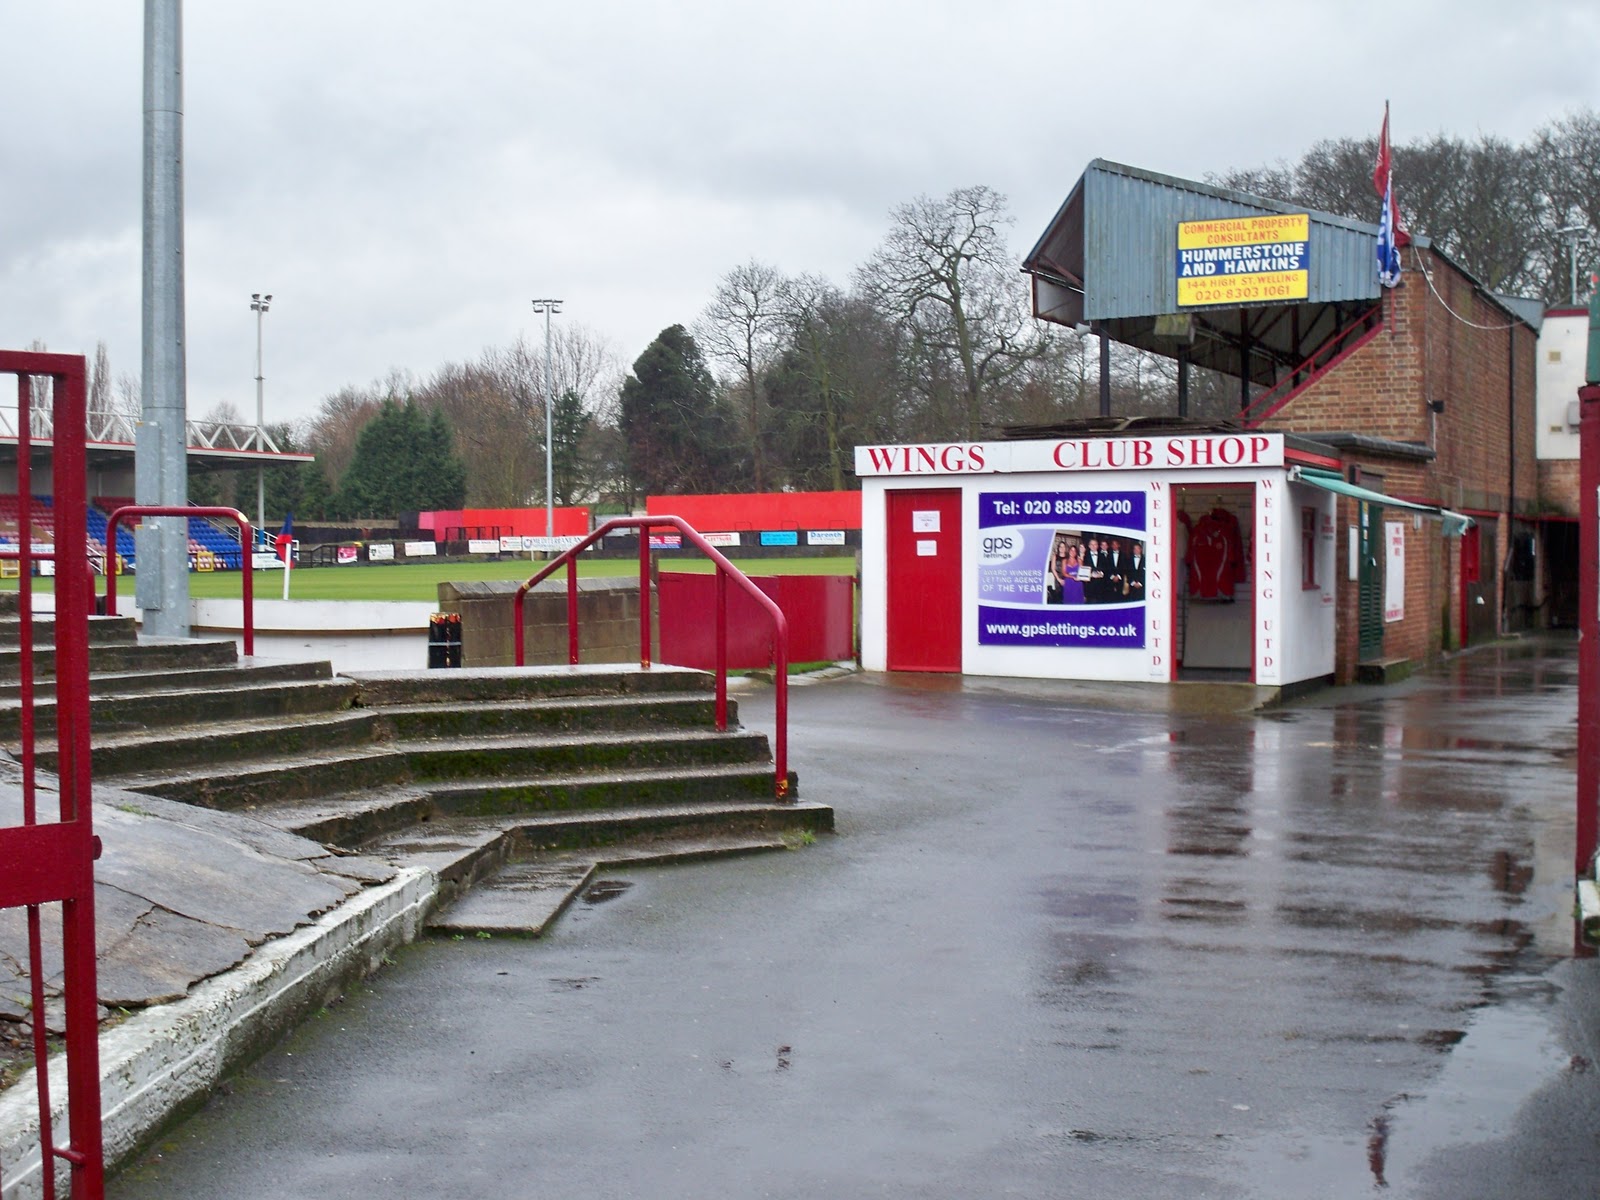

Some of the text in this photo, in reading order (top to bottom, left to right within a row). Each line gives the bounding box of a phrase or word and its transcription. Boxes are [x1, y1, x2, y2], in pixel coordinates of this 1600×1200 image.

[1184, 217, 1304, 234] COMMERCIAL PROPERTY
[1207, 230, 1279, 245] CONSULTANTS
[1181, 243, 1305, 264] HUMMERSTONE
[1182, 256, 1300, 277] AND HAWKINS
[1187, 280, 1207, 289] 144
[1210, 278, 1236, 287] HIGH
[1257, 273, 1299, 285] WELLING
[1264, 285, 1290, 297] 1061
[867, 437, 1270, 473] WINGS CLUB SHOP
[993, 499, 1132, 515] Tel: 020 8859 2200
[983, 537, 1013, 553] gps
[1150, 481, 1162, 600] WELLING
[1261, 479, 1273, 600] WELLING
[983, 552, 1012, 560] lettings
[982, 576, 1043, 584] LETTING AGENCY
[983, 569, 1043, 577] AWARD WINNERS
[982, 584, 1043, 593] OF THE YEAR
[986, 622, 1138, 639] www.gpslettings.co.uk
[1152, 619, 1162, 666] UTD
[1263, 619, 1273, 668] UTD
